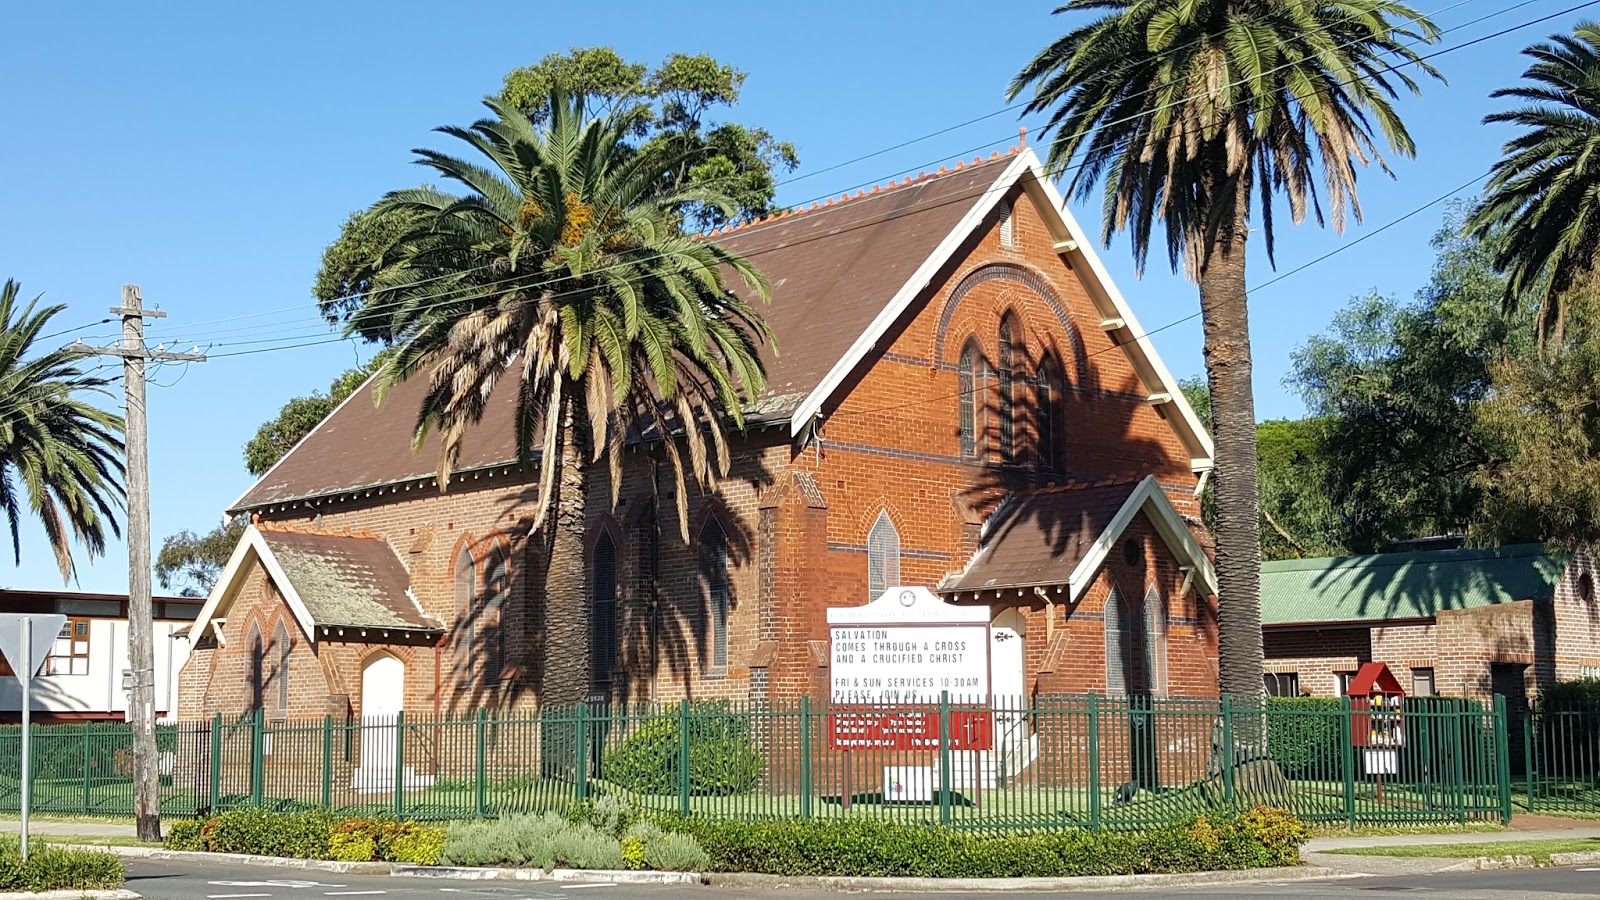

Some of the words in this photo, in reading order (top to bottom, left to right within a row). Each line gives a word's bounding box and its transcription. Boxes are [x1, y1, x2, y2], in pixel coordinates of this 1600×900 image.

[835, 630, 888, 640] SALVATION
[835, 642, 866, 652] COMES
[874, 642, 917, 651] THROUGH
[923, 642, 929, 651] A
[934, 641, 966, 651] CROSS
[836, 654, 854, 664] AND
[860, 654, 866, 663] A
[872, 653, 923, 663] CRUCIFIED
[929, 653, 963, 663] CHRIST
[835, 678, 850, 687] FRI
[853, 677, 859, 687] &
[862, 678, 882, 687] SUN
[887, 678, 934, 687] SERVICES
[835, 690, 871, 700] PLEASE
[879, 689, 900, 699] JOIN
